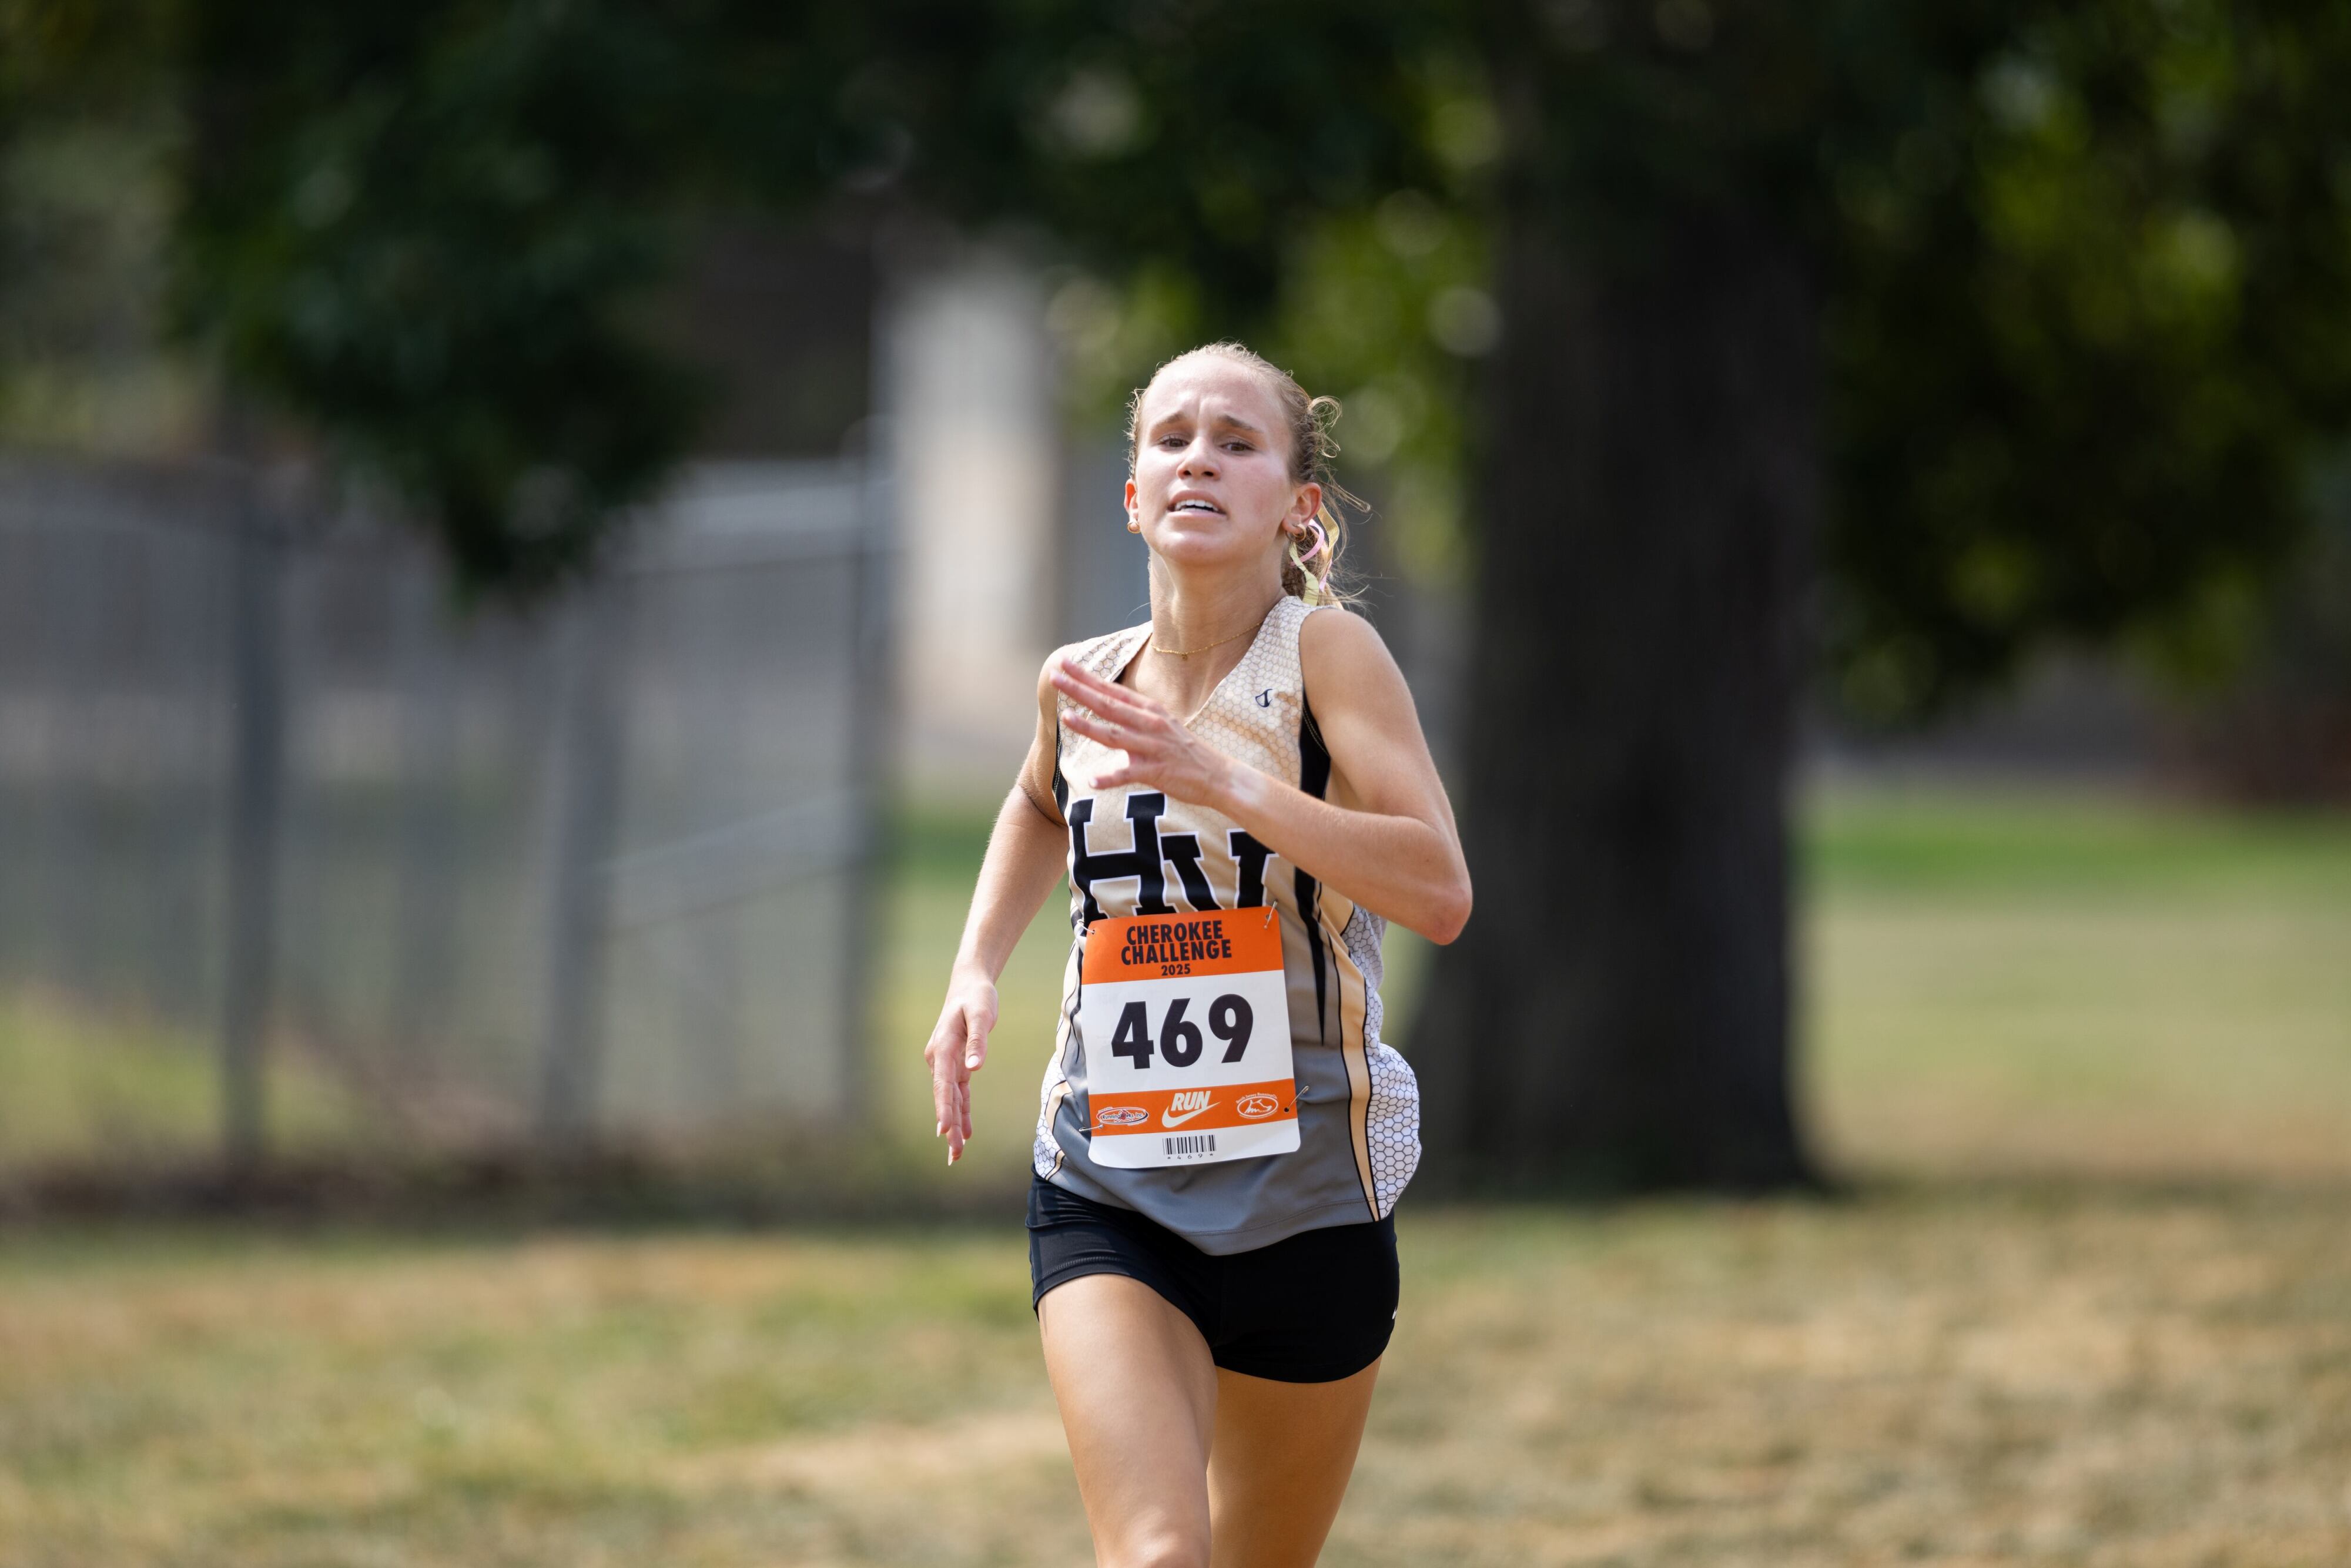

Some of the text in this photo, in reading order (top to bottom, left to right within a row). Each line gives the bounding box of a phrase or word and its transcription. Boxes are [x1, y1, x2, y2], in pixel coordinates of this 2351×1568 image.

[1127, 920, 1223, 945] CHEROKEE
[1121, 939, 1232, 965] CHALLENGE
[1161, 963, 1191, 976] 2025
[1111, 994, 1253, 1069] 469
[1171, 1091, 1211, 1111] RUN
